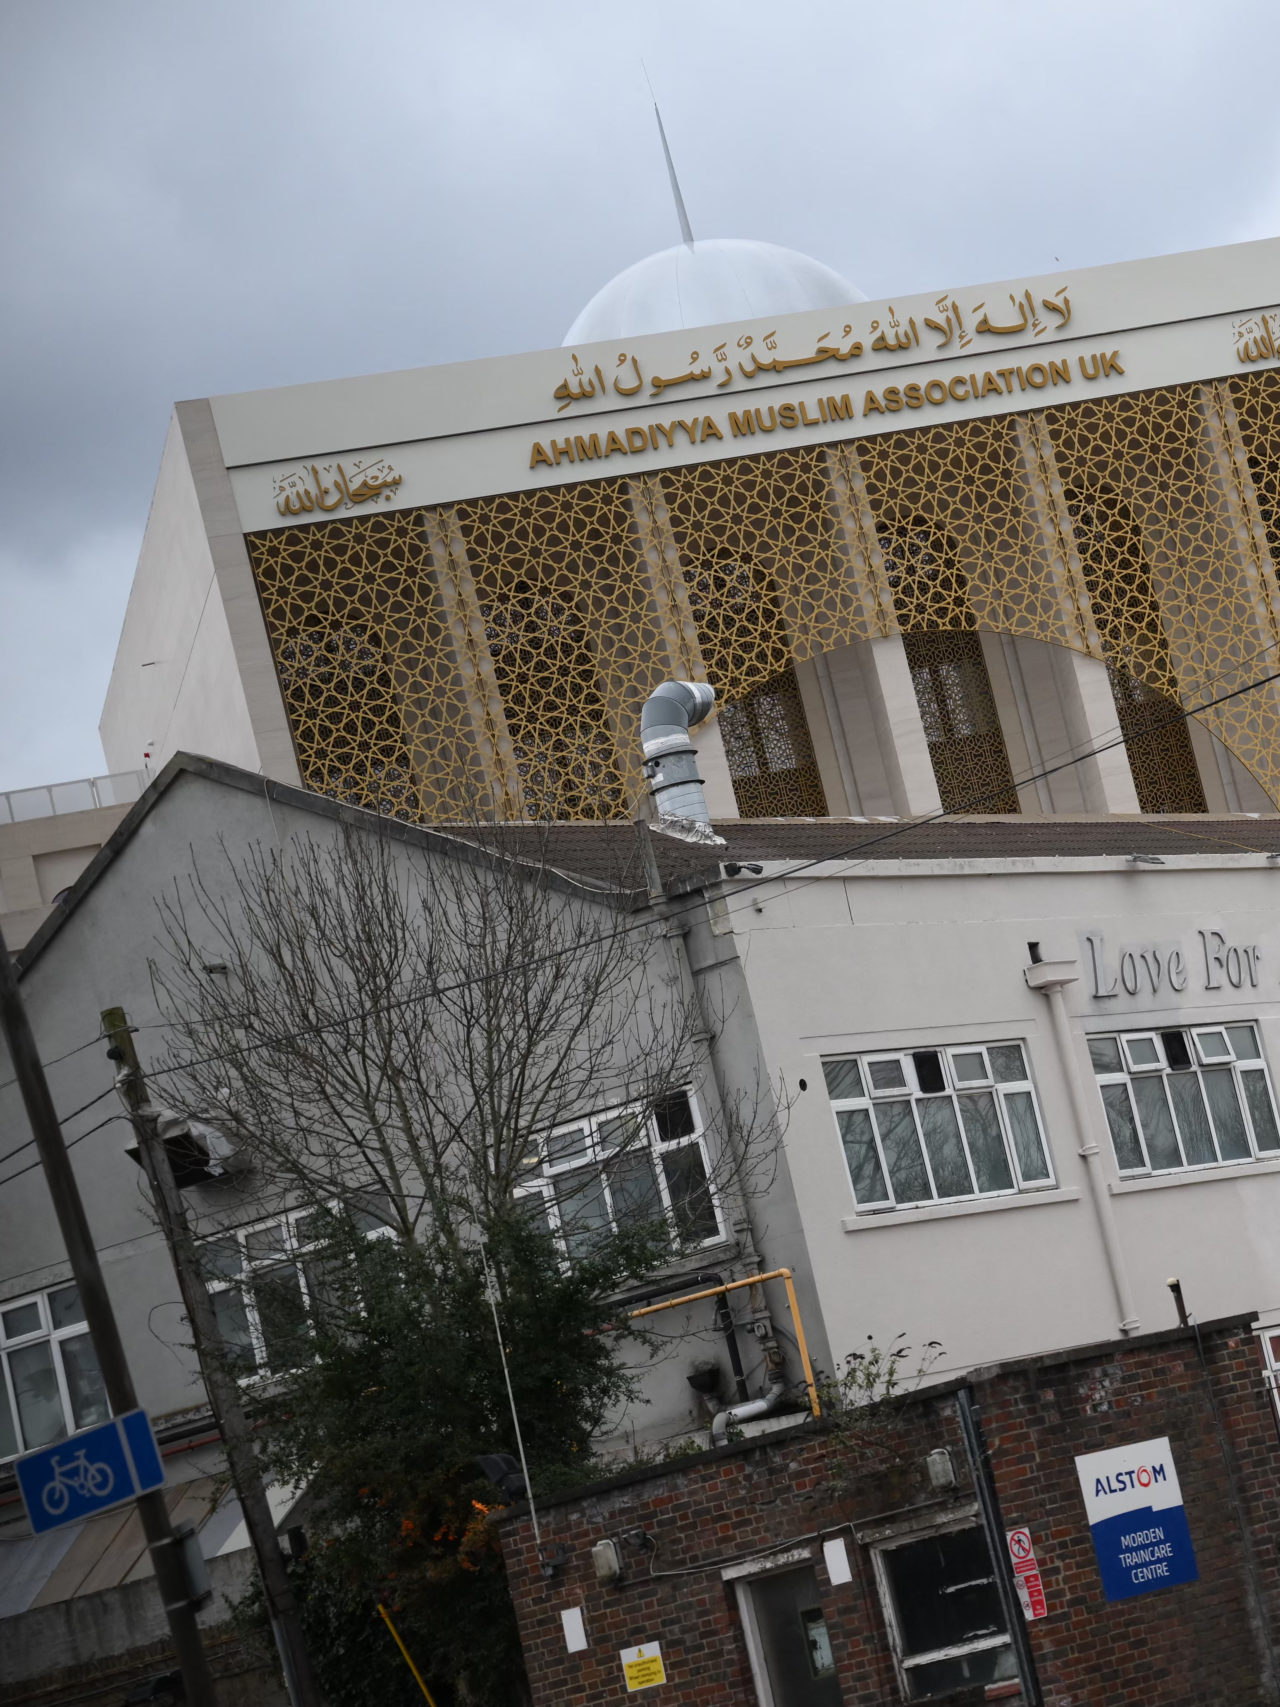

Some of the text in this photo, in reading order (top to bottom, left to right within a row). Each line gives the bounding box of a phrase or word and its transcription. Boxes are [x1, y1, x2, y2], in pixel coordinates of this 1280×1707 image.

[529, 349, 1126, 469] AHMADIYYA MUSLIM ASSOCIATION UK
[1086, 934, 1188, 999] Love
[1198, 928, 1260, 990] For
[1095, 1463, 1167, 1497] ALSTOM
[1120, 1526, 1165, 1550] MORDEN
[1118, 1543, 1174, 1569] TRAINCARE
[1131, 1562, 1170, 1584] CENTRE
